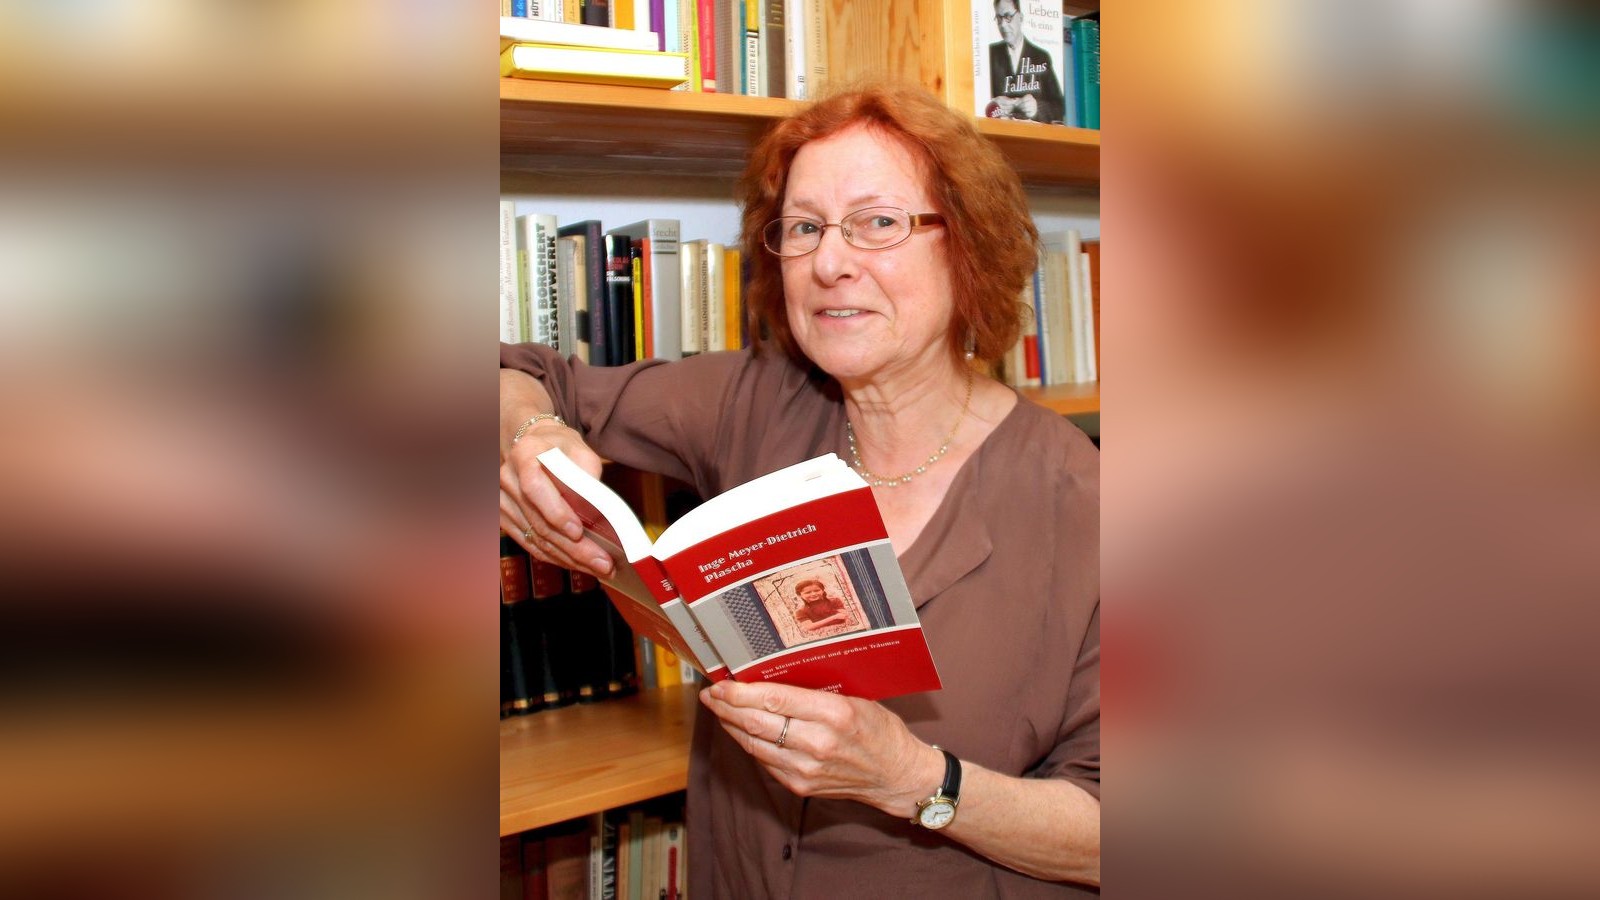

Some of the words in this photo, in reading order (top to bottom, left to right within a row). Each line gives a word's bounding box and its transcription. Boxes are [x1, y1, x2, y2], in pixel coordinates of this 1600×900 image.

[530, 0, 539, 16] HÜT
[1029, 3, 1060, 19] Leben
[1020, 57, 1047, 74] Hans
[1004, 74, 1040, 93] Fallada
[535, 223, 548, 309] BORCHERT
[547, 235, 559, 350] GESAMTWERK
[537, 314, 550, 346] ANG
[697, 555, 726, 574] Inge
[728, 523, 817, 561] Meyer-Dietrich
[704, 558, 754, 583] Plascha
[828, 650, 842, 658] und
[869, 639, 900, 650] Träumen
[763, 669, 788, 680] Roman
